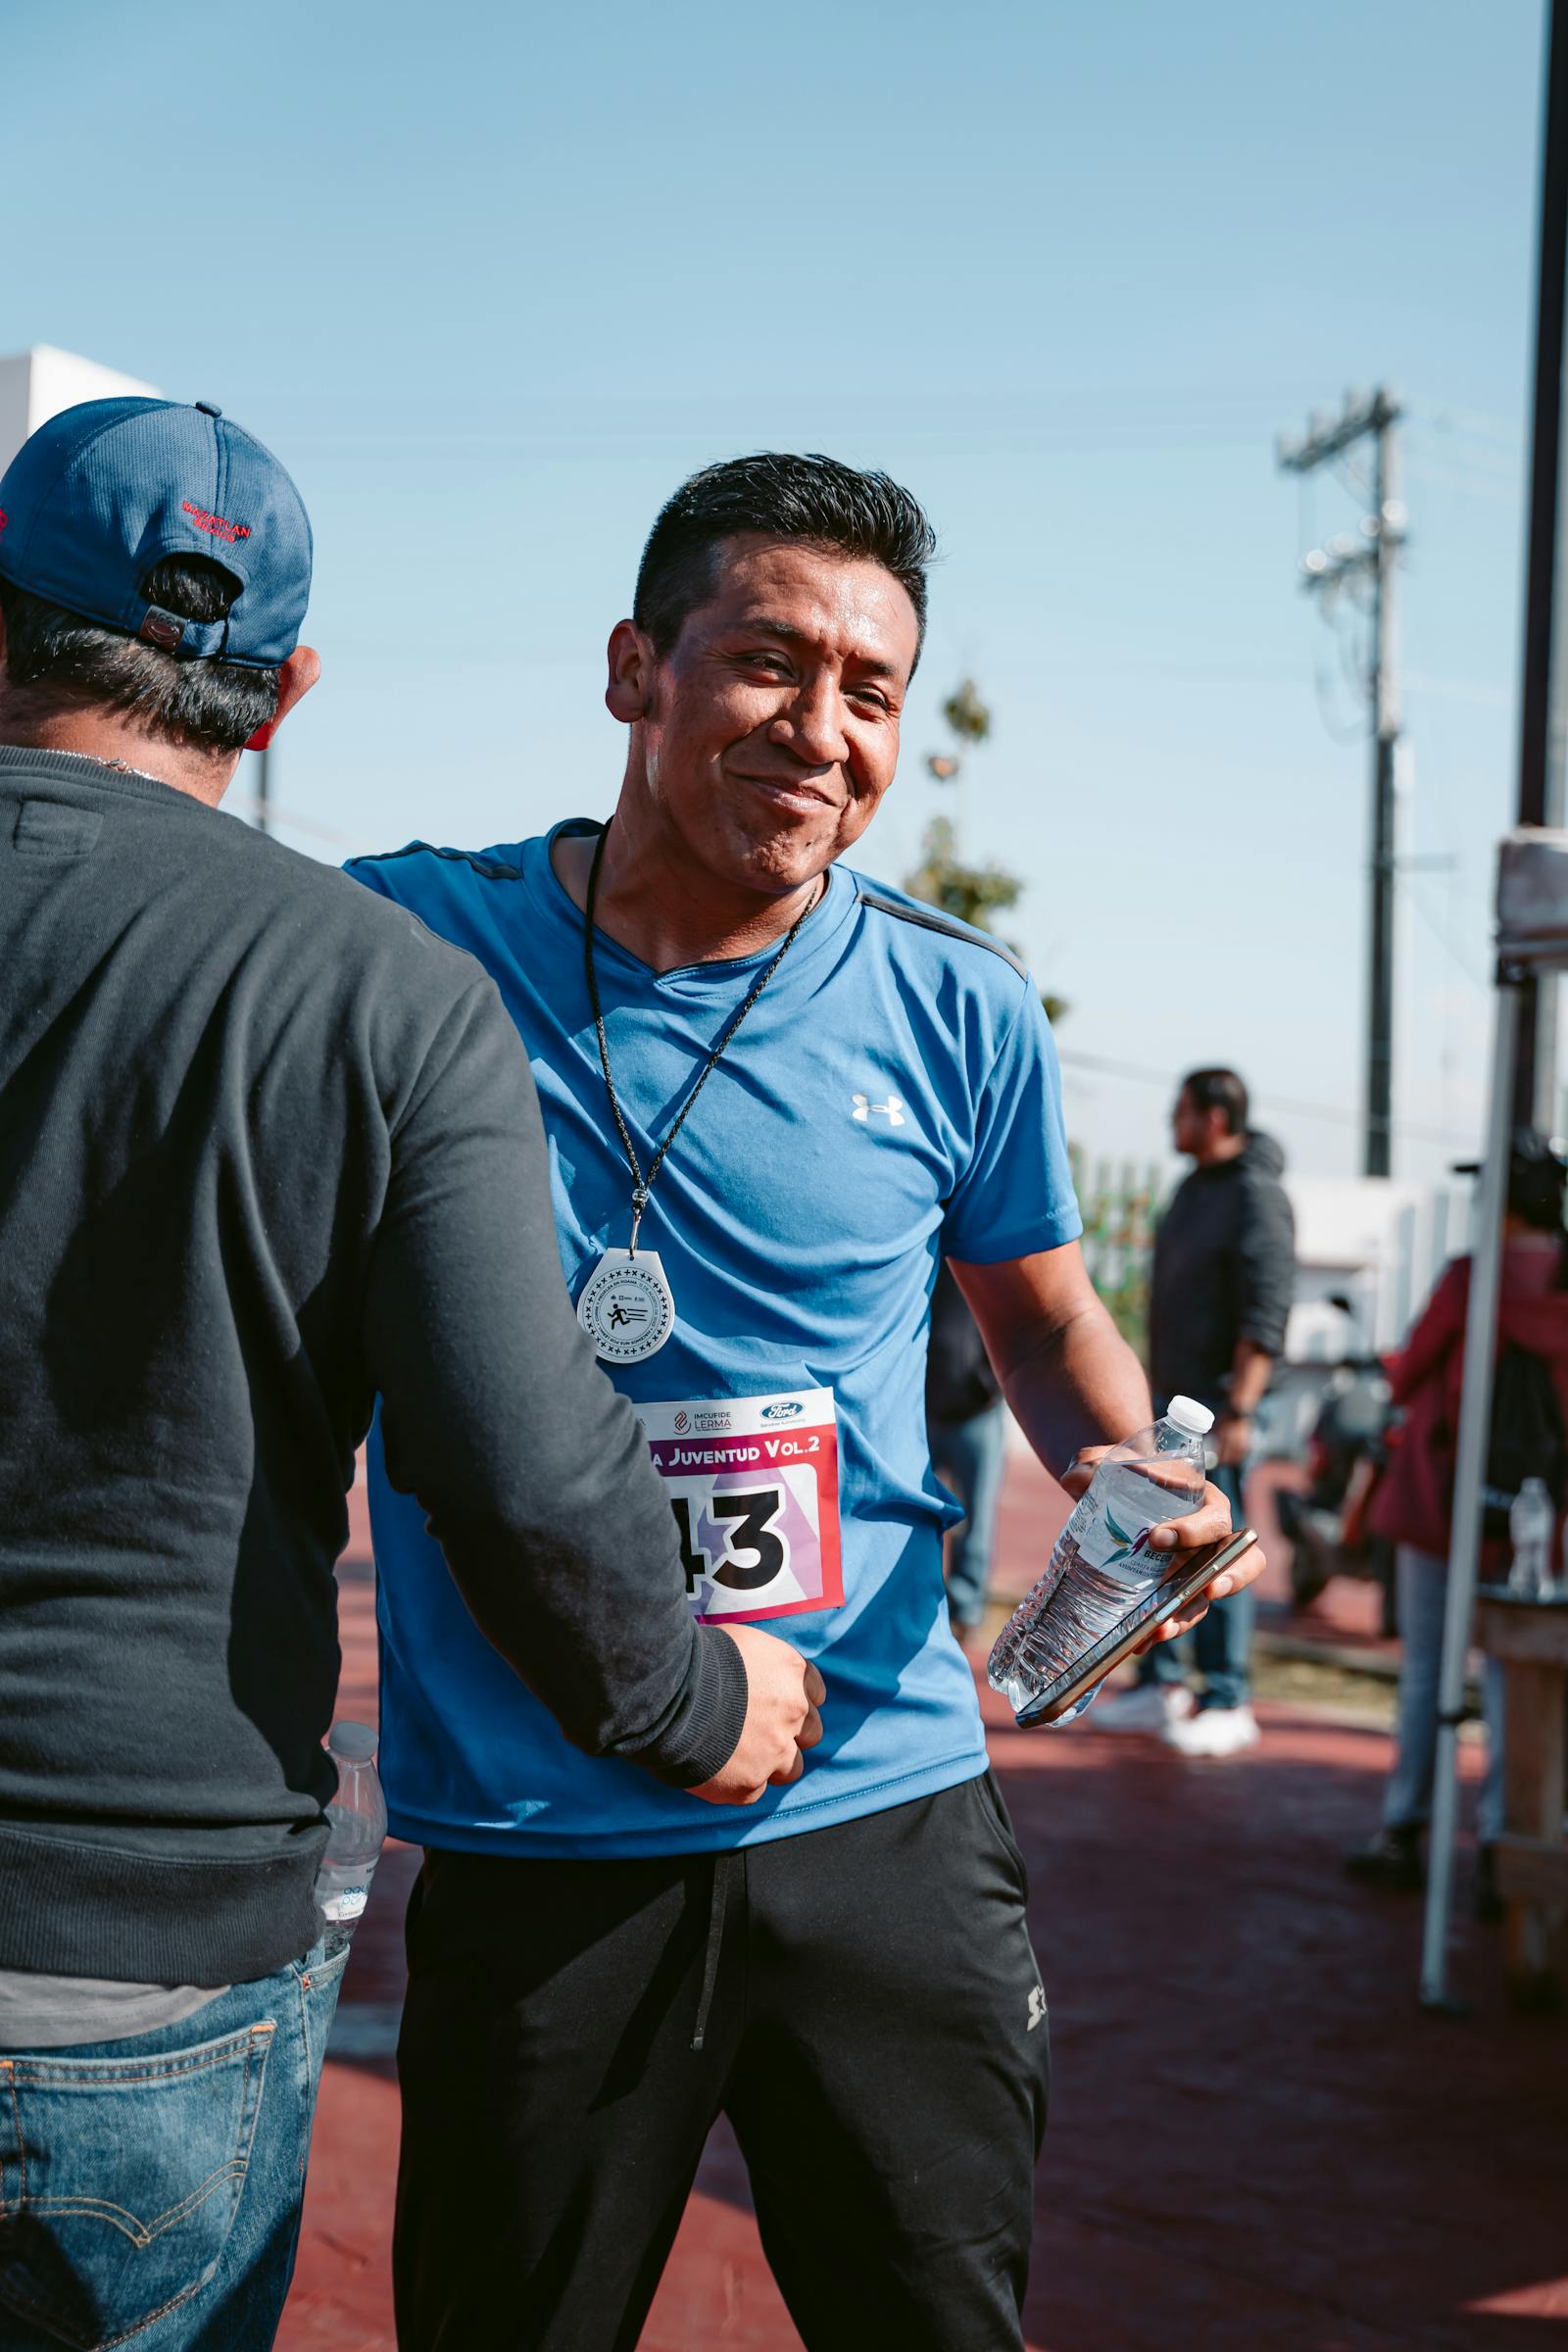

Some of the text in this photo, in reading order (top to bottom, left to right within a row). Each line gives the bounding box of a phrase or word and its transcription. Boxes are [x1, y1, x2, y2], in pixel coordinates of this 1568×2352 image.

[694, 1411, 731, 1420] IMCUFIDE
[766, 1402, 799, 1418] Ford
[694, 1419, 732, 1429] LERMA
[668, 1446, 760, 1467] JUVENTUD
[764, 1436, 820, 1458] VOL.2
